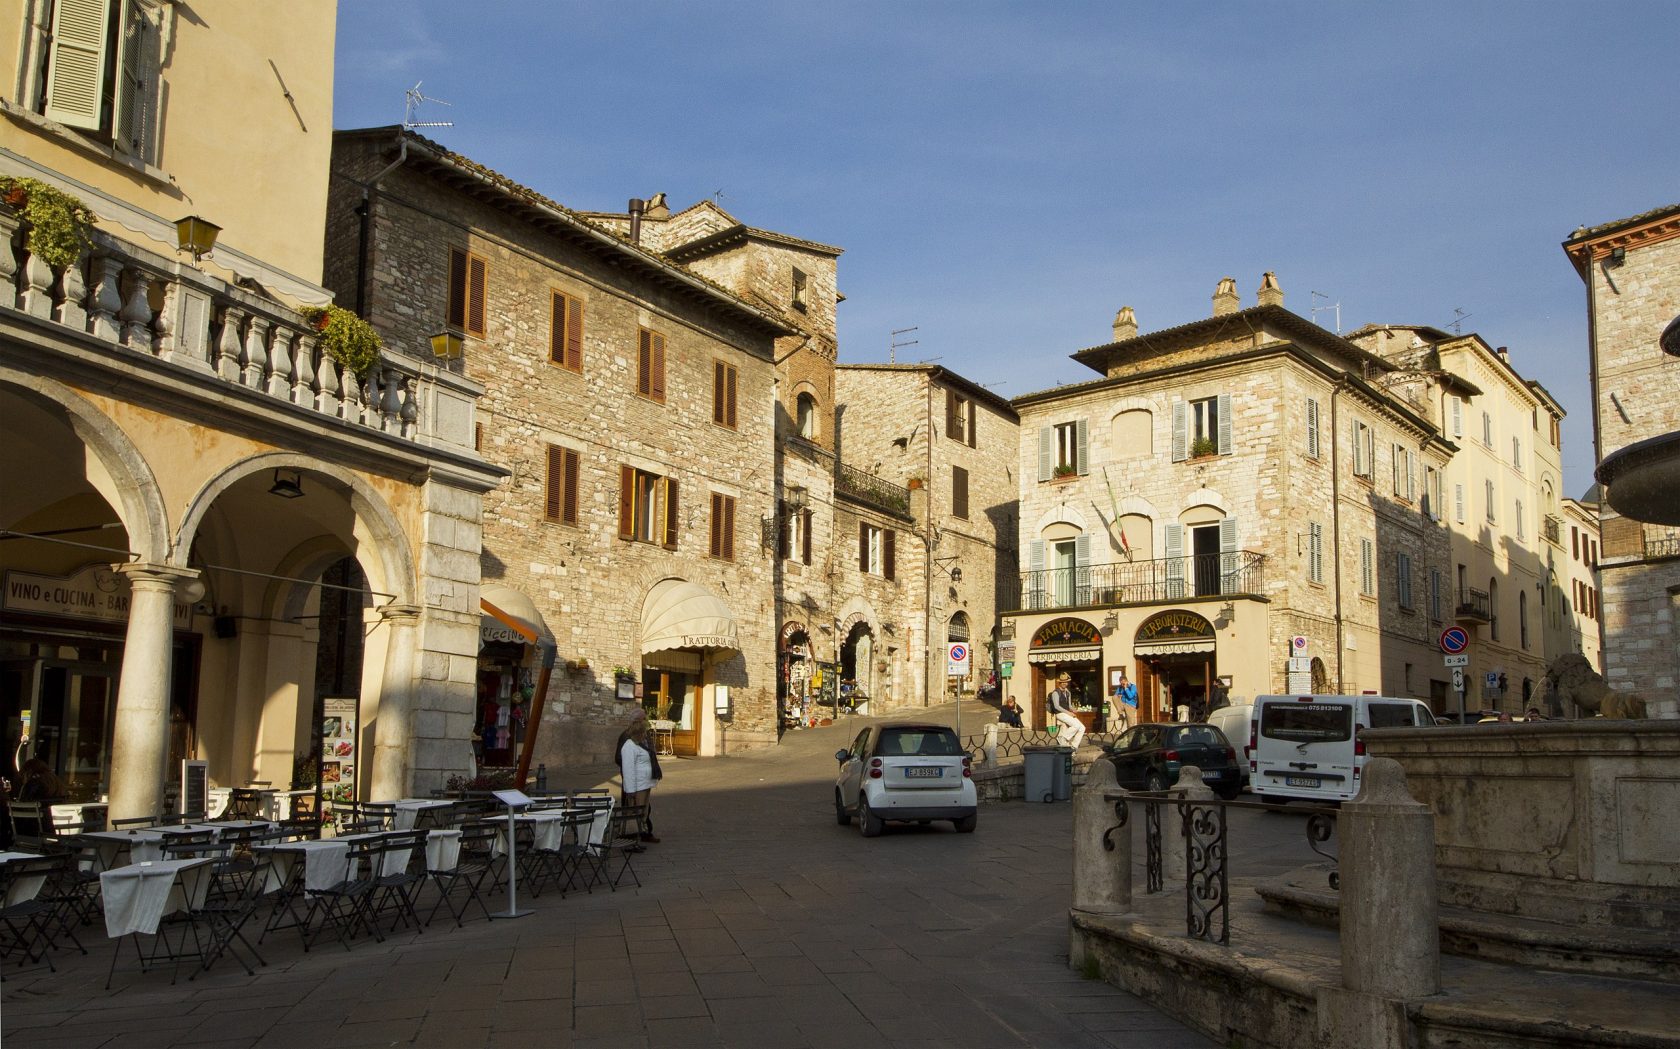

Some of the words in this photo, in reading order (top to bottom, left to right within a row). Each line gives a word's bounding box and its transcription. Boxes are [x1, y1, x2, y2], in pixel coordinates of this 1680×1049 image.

[11, 582, 41, 600] VINO
[44, 592, 50, 602] e
[54, 588, 96, 608] CUCINA
[108, 595, 129, 612] BAR
[1040, 621, 1093, 641] FARMACIA
[1144, 613, 1206, 636] ERBORISTERIA
[681, 635, 727, 646] TRATTORIA
[1037, 651, 1093, 661] ERBORISTERIA
[1152, 644, 1196, 653] FARMACIA
